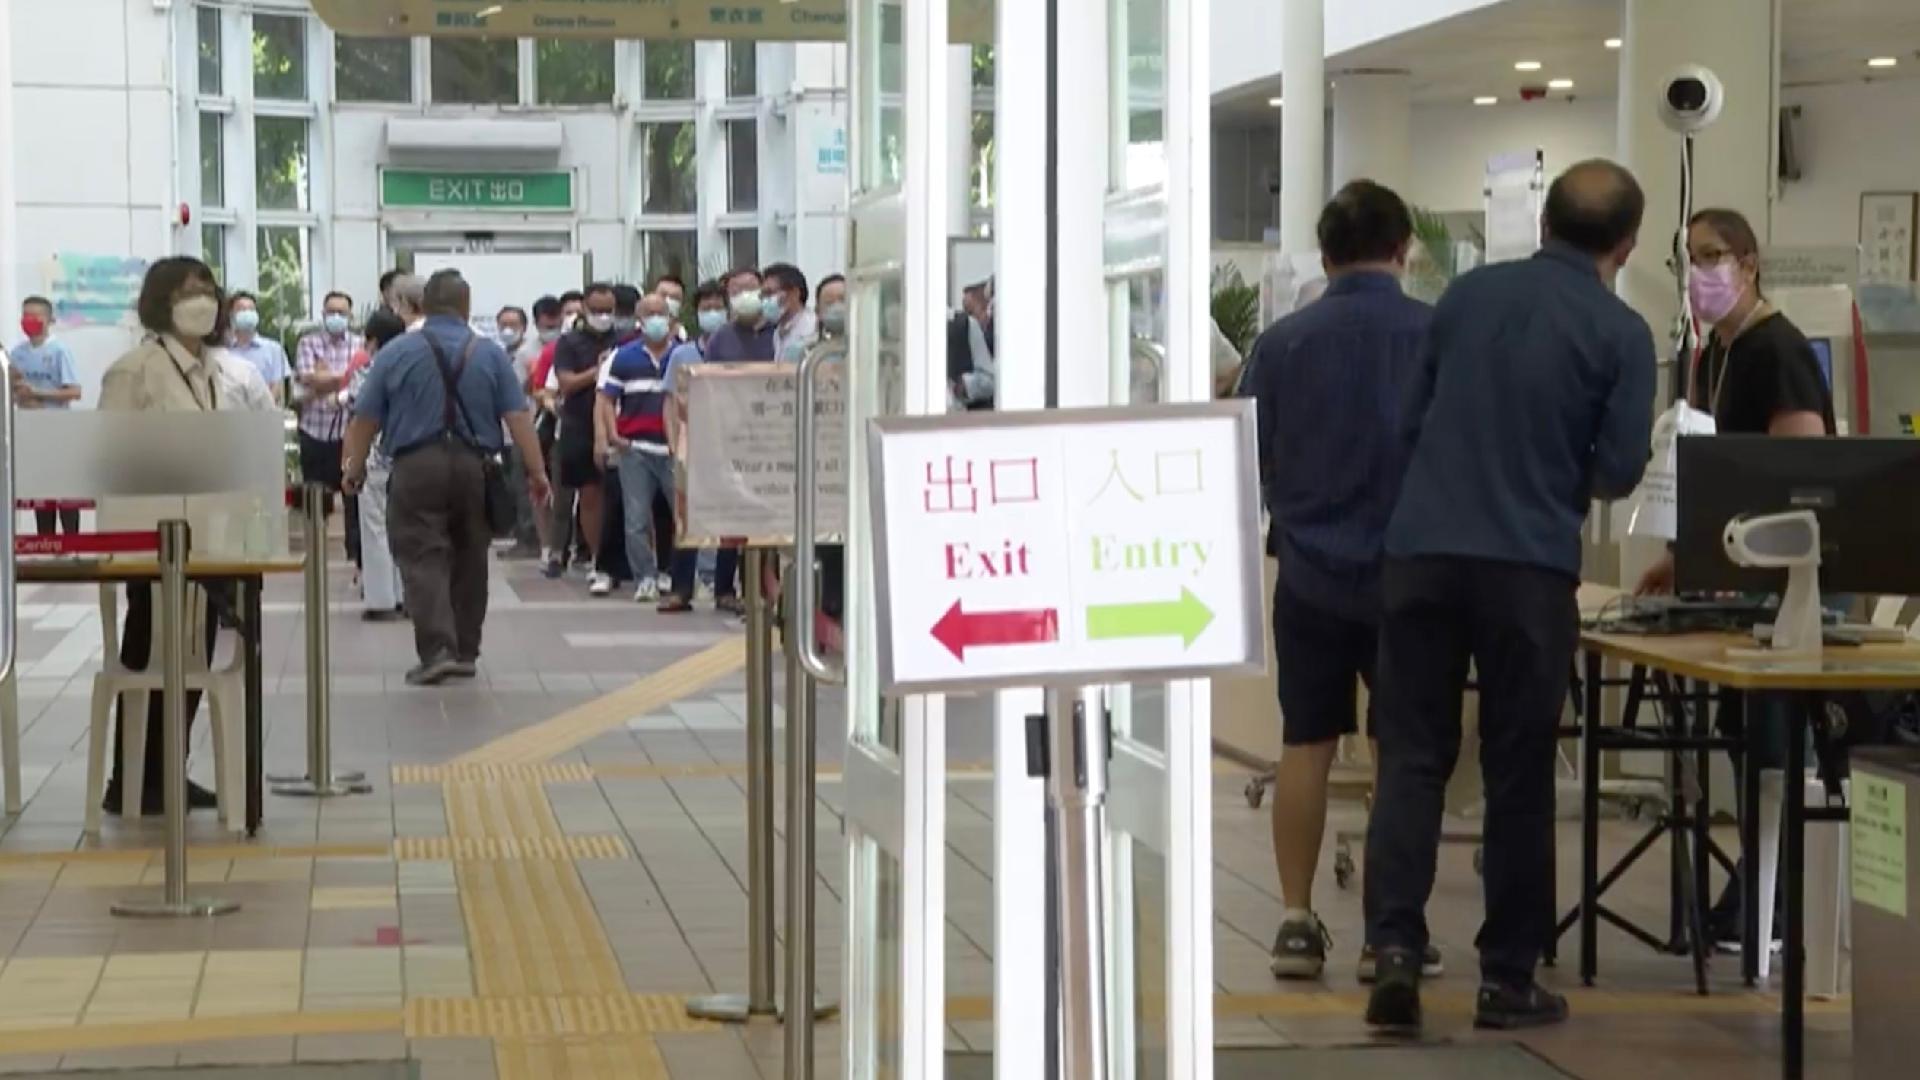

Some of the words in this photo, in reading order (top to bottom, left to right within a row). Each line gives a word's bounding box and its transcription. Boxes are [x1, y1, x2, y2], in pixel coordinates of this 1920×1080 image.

[429, 178, 485, 200] EXIT
[490, 179, 524, 201] 出口
[923, 456, 1039, 514] 出口
[1086, 447, 1205, 507] 入口
[943, 538, 1033, 581] Exit
[1091, 533, 1212, 577] Entry
